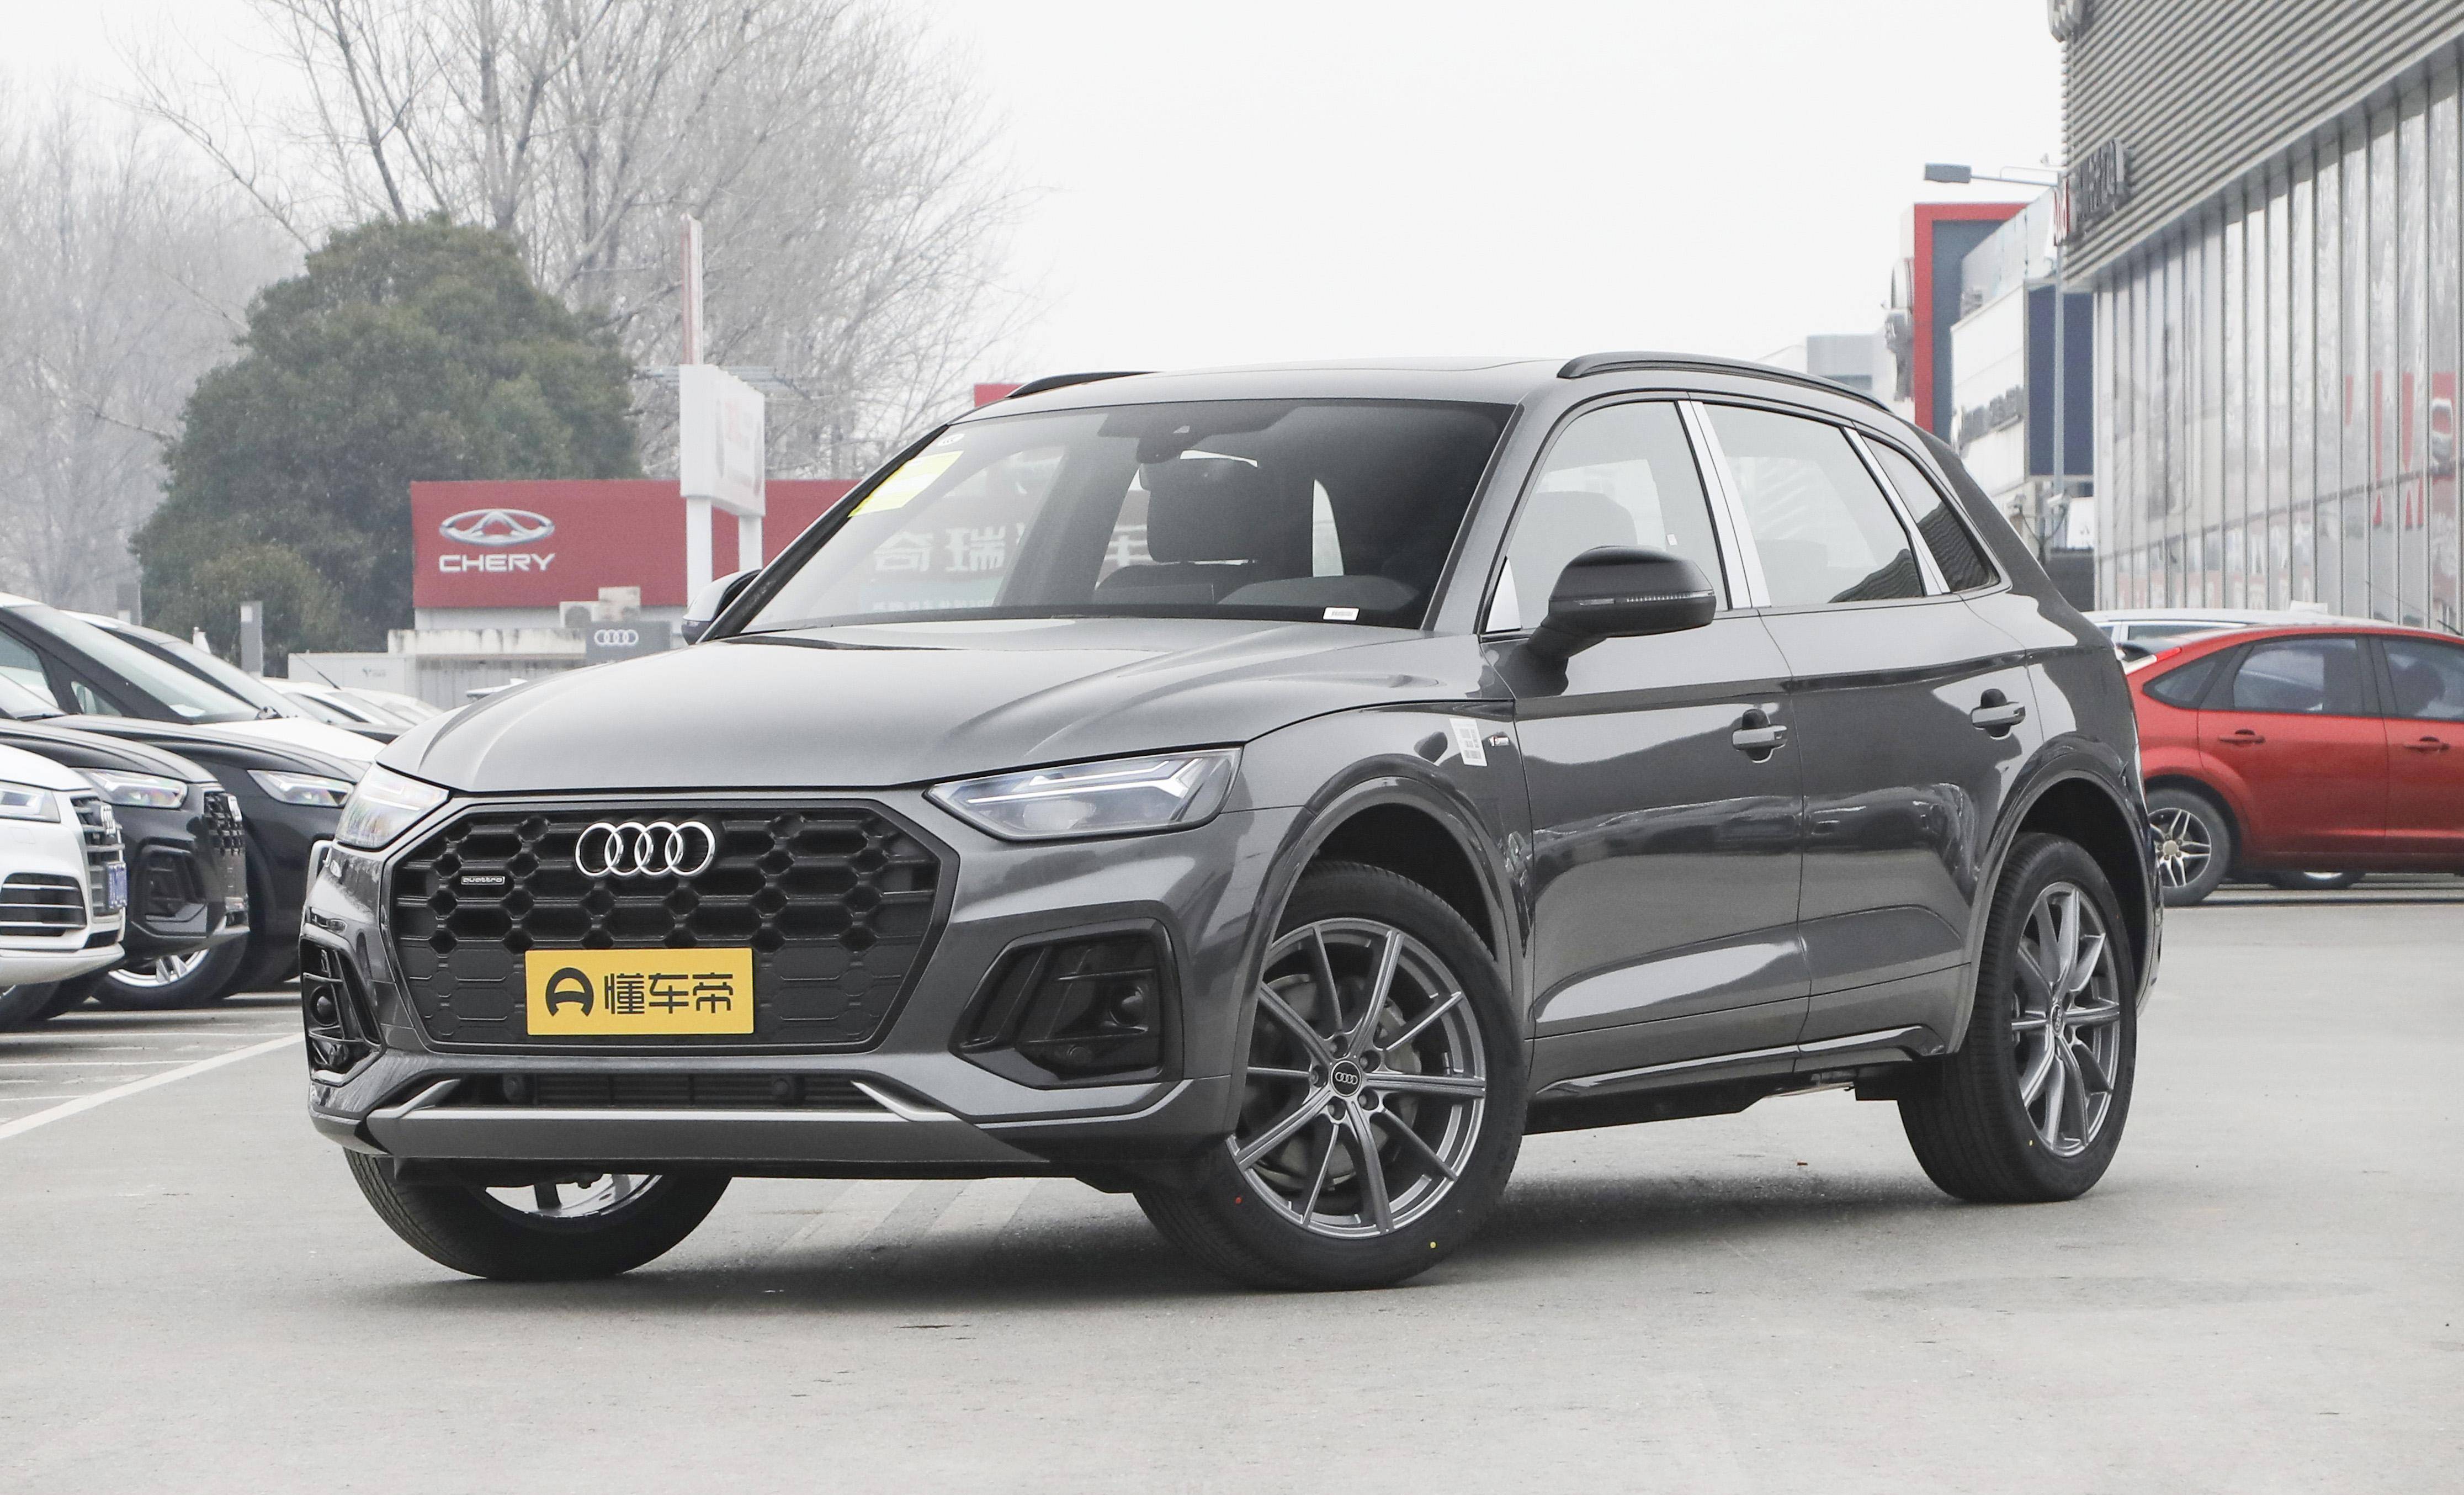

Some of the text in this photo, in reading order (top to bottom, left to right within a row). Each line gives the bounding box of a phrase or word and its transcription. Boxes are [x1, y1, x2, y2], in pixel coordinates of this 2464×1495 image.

[439, 553, 555, 572] CHERY
[604, 972, 733, 1014] 懂车帝
